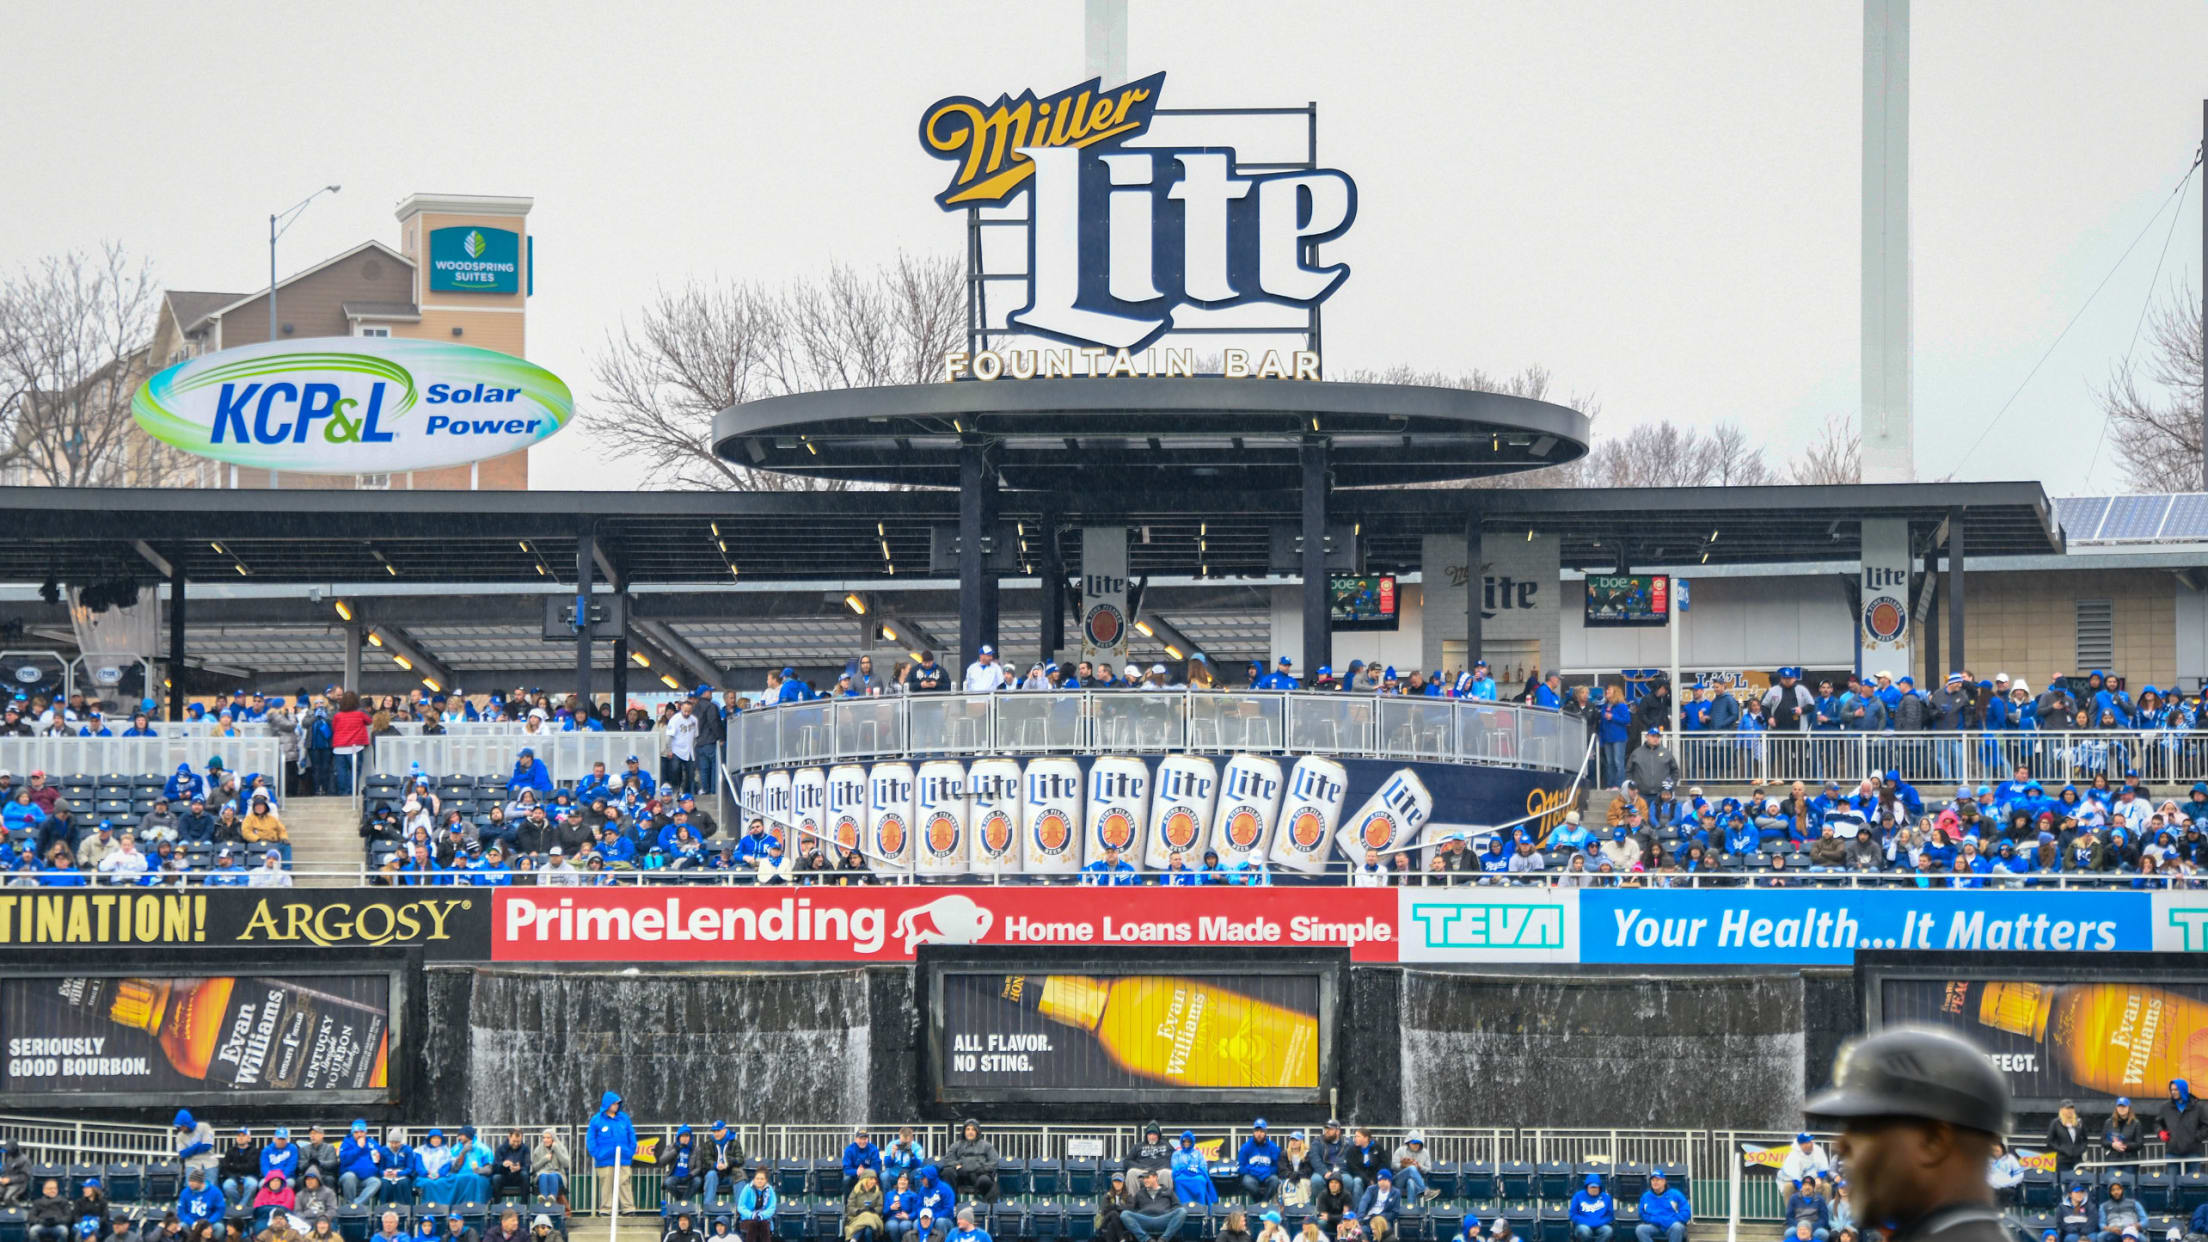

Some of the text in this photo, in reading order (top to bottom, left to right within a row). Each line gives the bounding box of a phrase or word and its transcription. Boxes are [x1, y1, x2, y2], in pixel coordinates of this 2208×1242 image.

[926, 88, 1150, 204] Miller
[1012, 146, 1350, 349] Lite
[435, 260, 514, 272] WOODSPRING
[455, 272, 494, 282] SUITES
[945, 348, 1321, 383] FOUNTAIN BAR
[425, 384, 521, 404] Solar
[210, 382, 396, 445] KCP&L
[425, 415, 542, 435] Power
[1086, 574, 1124, 598] Lite
[1865, 567, 1905, 591] Lite
[794, 783, 823, 816] Lite
[830, 780, 864, 813] Lite
[873, 778, 911, 811] Lite
[920, 776, 962, 809] Lite
[972, 775, 1018, 808] Lite
[1029, 773, 1077, 805] Lite
[1095, 771, 1143, 804] Lite
[1160, 768, 1211, 802] Lite
[1226, 767, 1277, 801] Lite
[1293, 767, 1341, 803] Lite
[1382, 777, 1423, 826] Lite
[0, 895, 207, 943] TINATION!
[505, 898, 886, 953] PrimeLending
[1005, 916, 1093, 942] Home
[1103, 916, 1191, 942] Loans
[1199, 916, 1281, 942] Made
[1412, 903, 1564, 948] TEVA
[1614, 909, 1706, 947] Your
[1946, 911, 2116, 950] Matters
[1157, 988, 1187, 1041] Evan
[2111, 993, 2141, 1049] Evan
[9, 1037, 105, 1056] SERIOUSLY
[218, 1003, 256, 1066] Evan
[953, 1034, 1053, 1051] ALL FLAVOR.
[1166, 992, 1206, 1075] Williams
[2123, 996, 2162, 1086] Williams
[9, 1057, 151, 1077] GOOD BOURBON.
[304, 1014, 334, 1088] KENTUCKY
[953, 1054, 1034, 1072] NO STING.
[2021, 1156, 2056, 1169] SON
